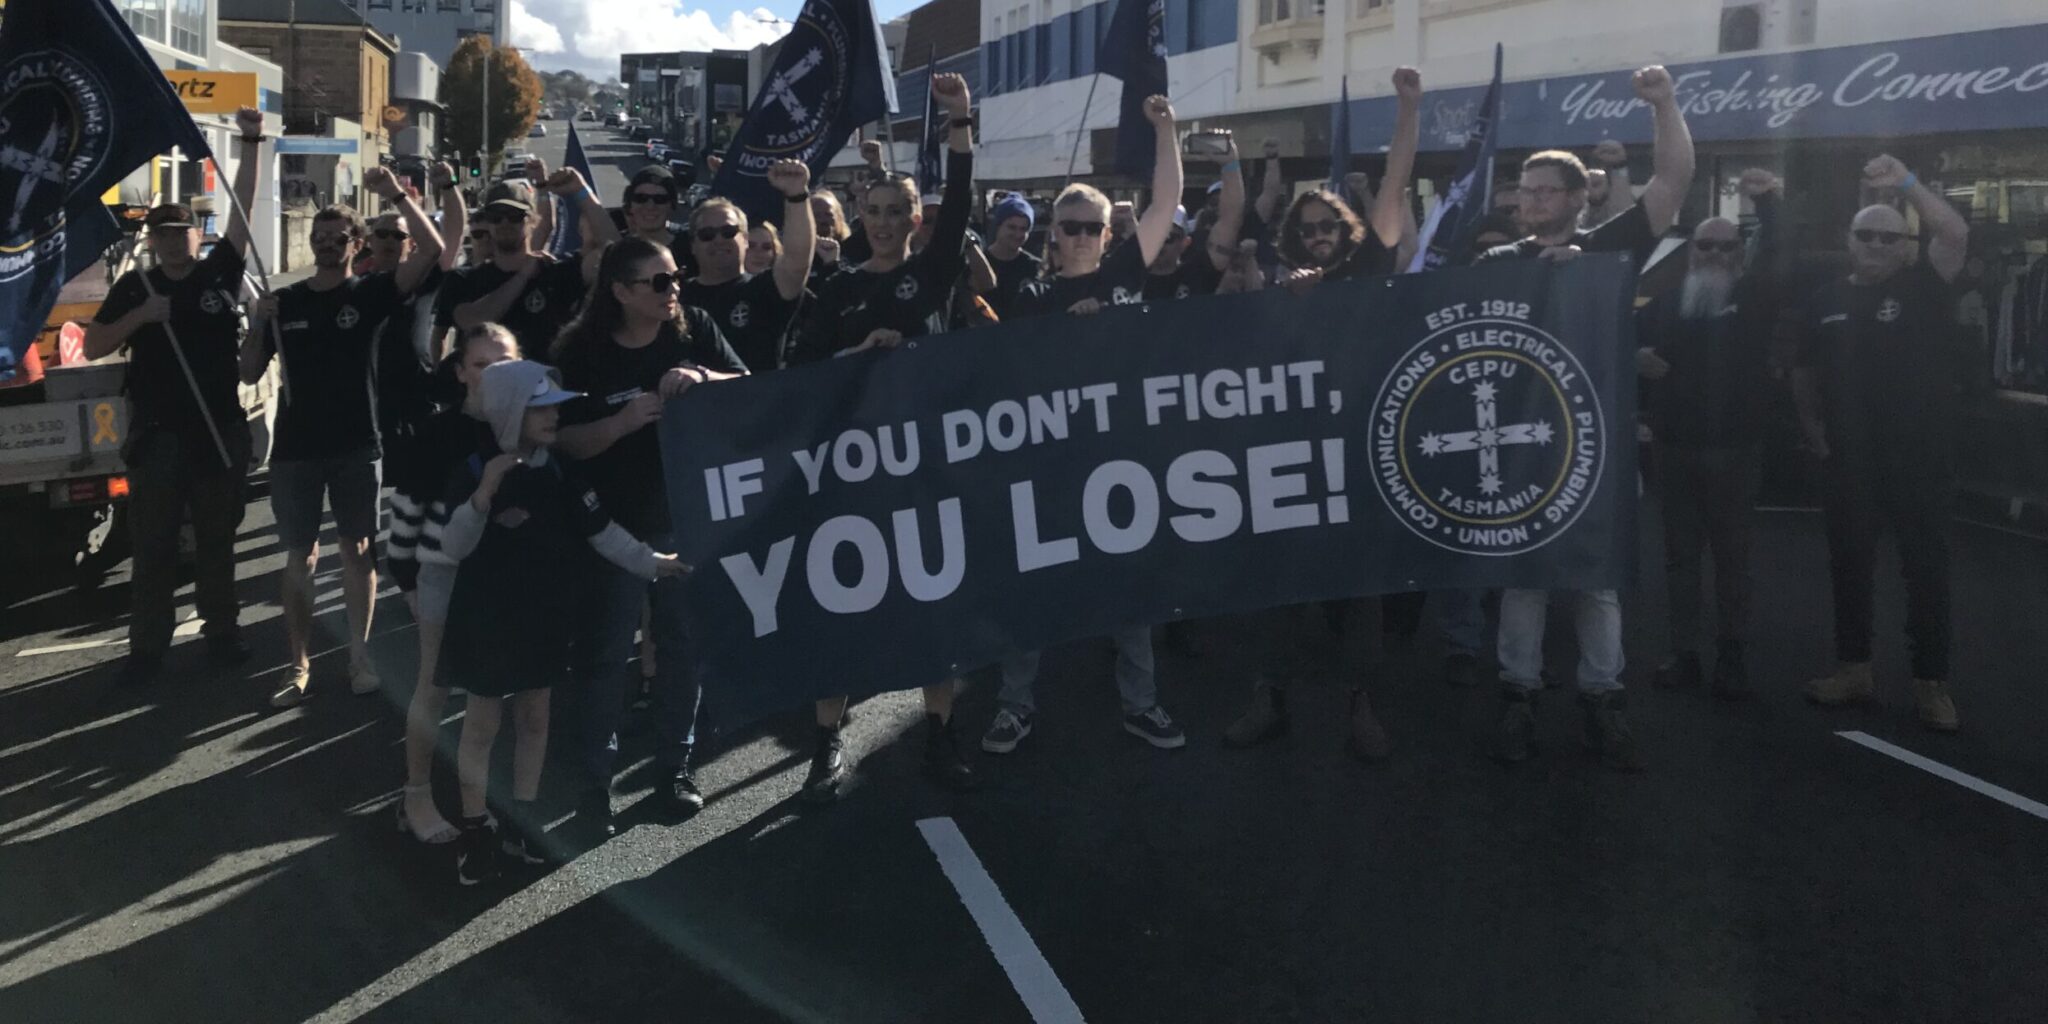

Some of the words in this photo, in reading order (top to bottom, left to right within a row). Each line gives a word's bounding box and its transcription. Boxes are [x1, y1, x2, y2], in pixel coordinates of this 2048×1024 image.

[1560, 80, 1653, 126] Your
[1424, 302, 1475, 331] EST.
[1481, 300, 1531, 320] 1912
[1449, 359, 1517, 385] CEPU
[1455, 329, 1577, 390] ELECTRICAL
[704, 457, 765, 522] IF
[792, 420, 920, 496] YOU
[942, 382, 1118, 464] DON'T
[1143, 360, 1342, 427] FIGHT,
[1377, 350, 1439, 530] COMMUNICATIONS
[1544, 410, 1595, 524] PLUMBING
[1438, 483, 1544, 515] TASMANIA
[719, 497, 967, 639] YOU
[1009, 438, 1350, 573] LOSE!
[1458, 525, 1530, 547] UNION
